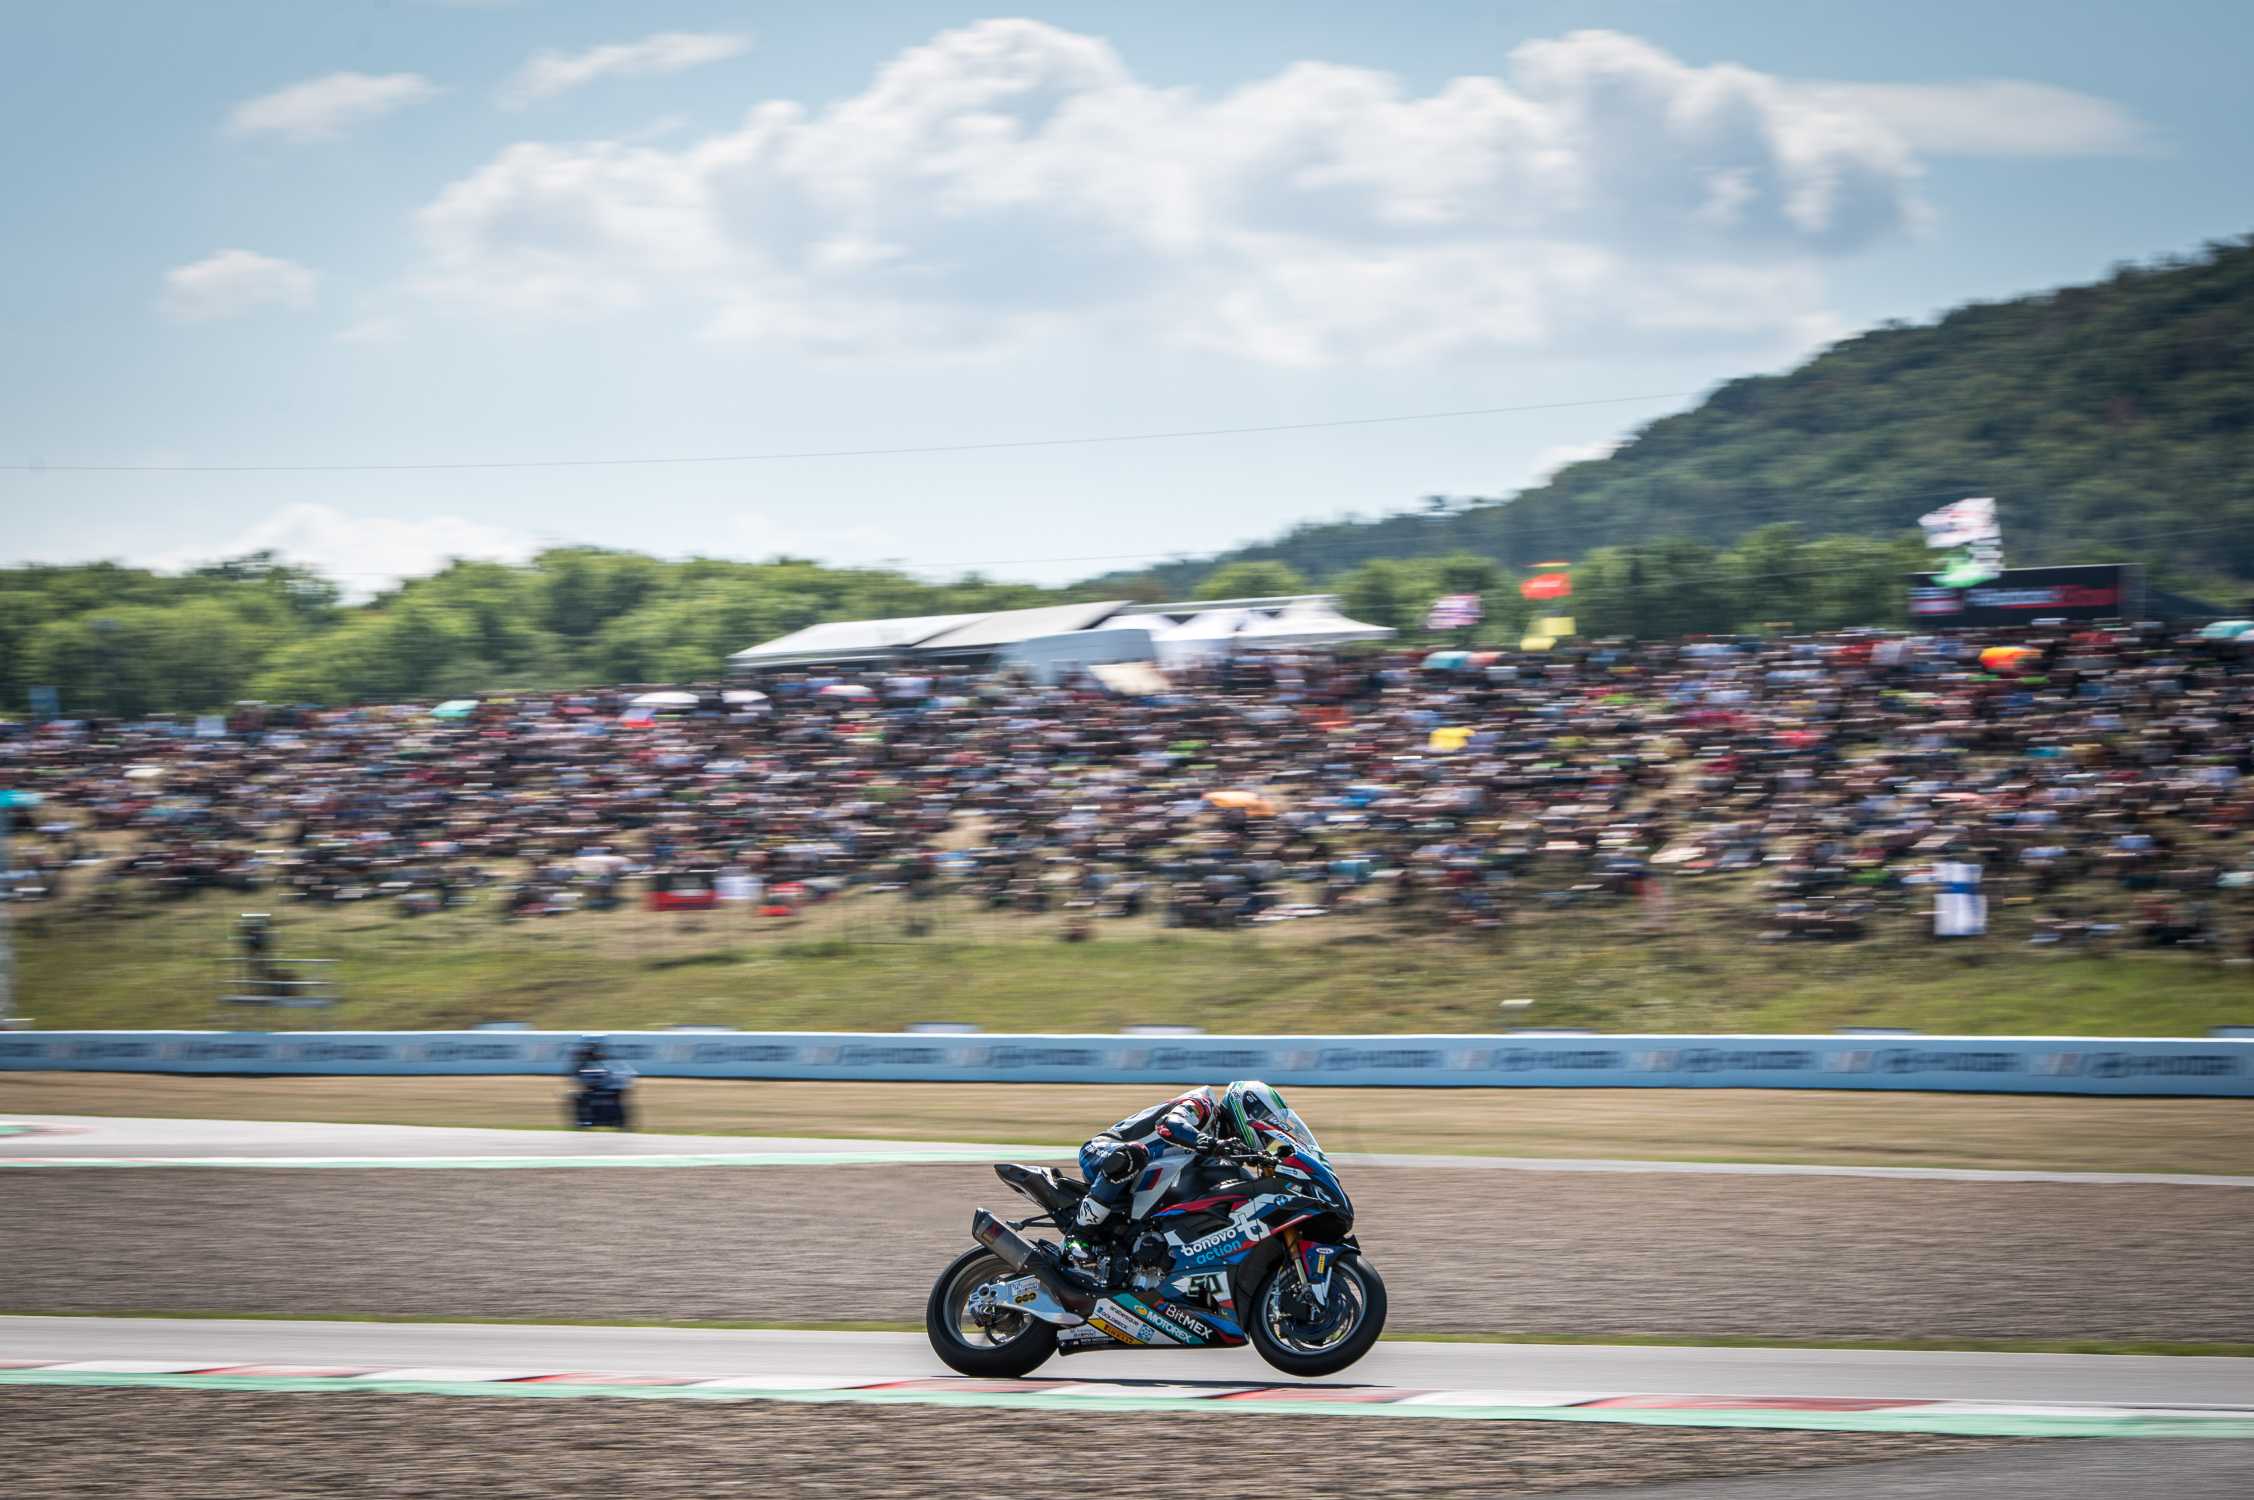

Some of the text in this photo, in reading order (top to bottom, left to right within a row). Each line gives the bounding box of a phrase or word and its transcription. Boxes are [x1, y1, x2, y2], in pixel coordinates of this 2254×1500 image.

[1181, 1227, 1237, 1257] bonovo
[1196, 1239, 1242, 1265] action
[1147, 1311, 1193, 1343] MOTOREX
[1166, 1304, 1213, 1340] BitMEX
